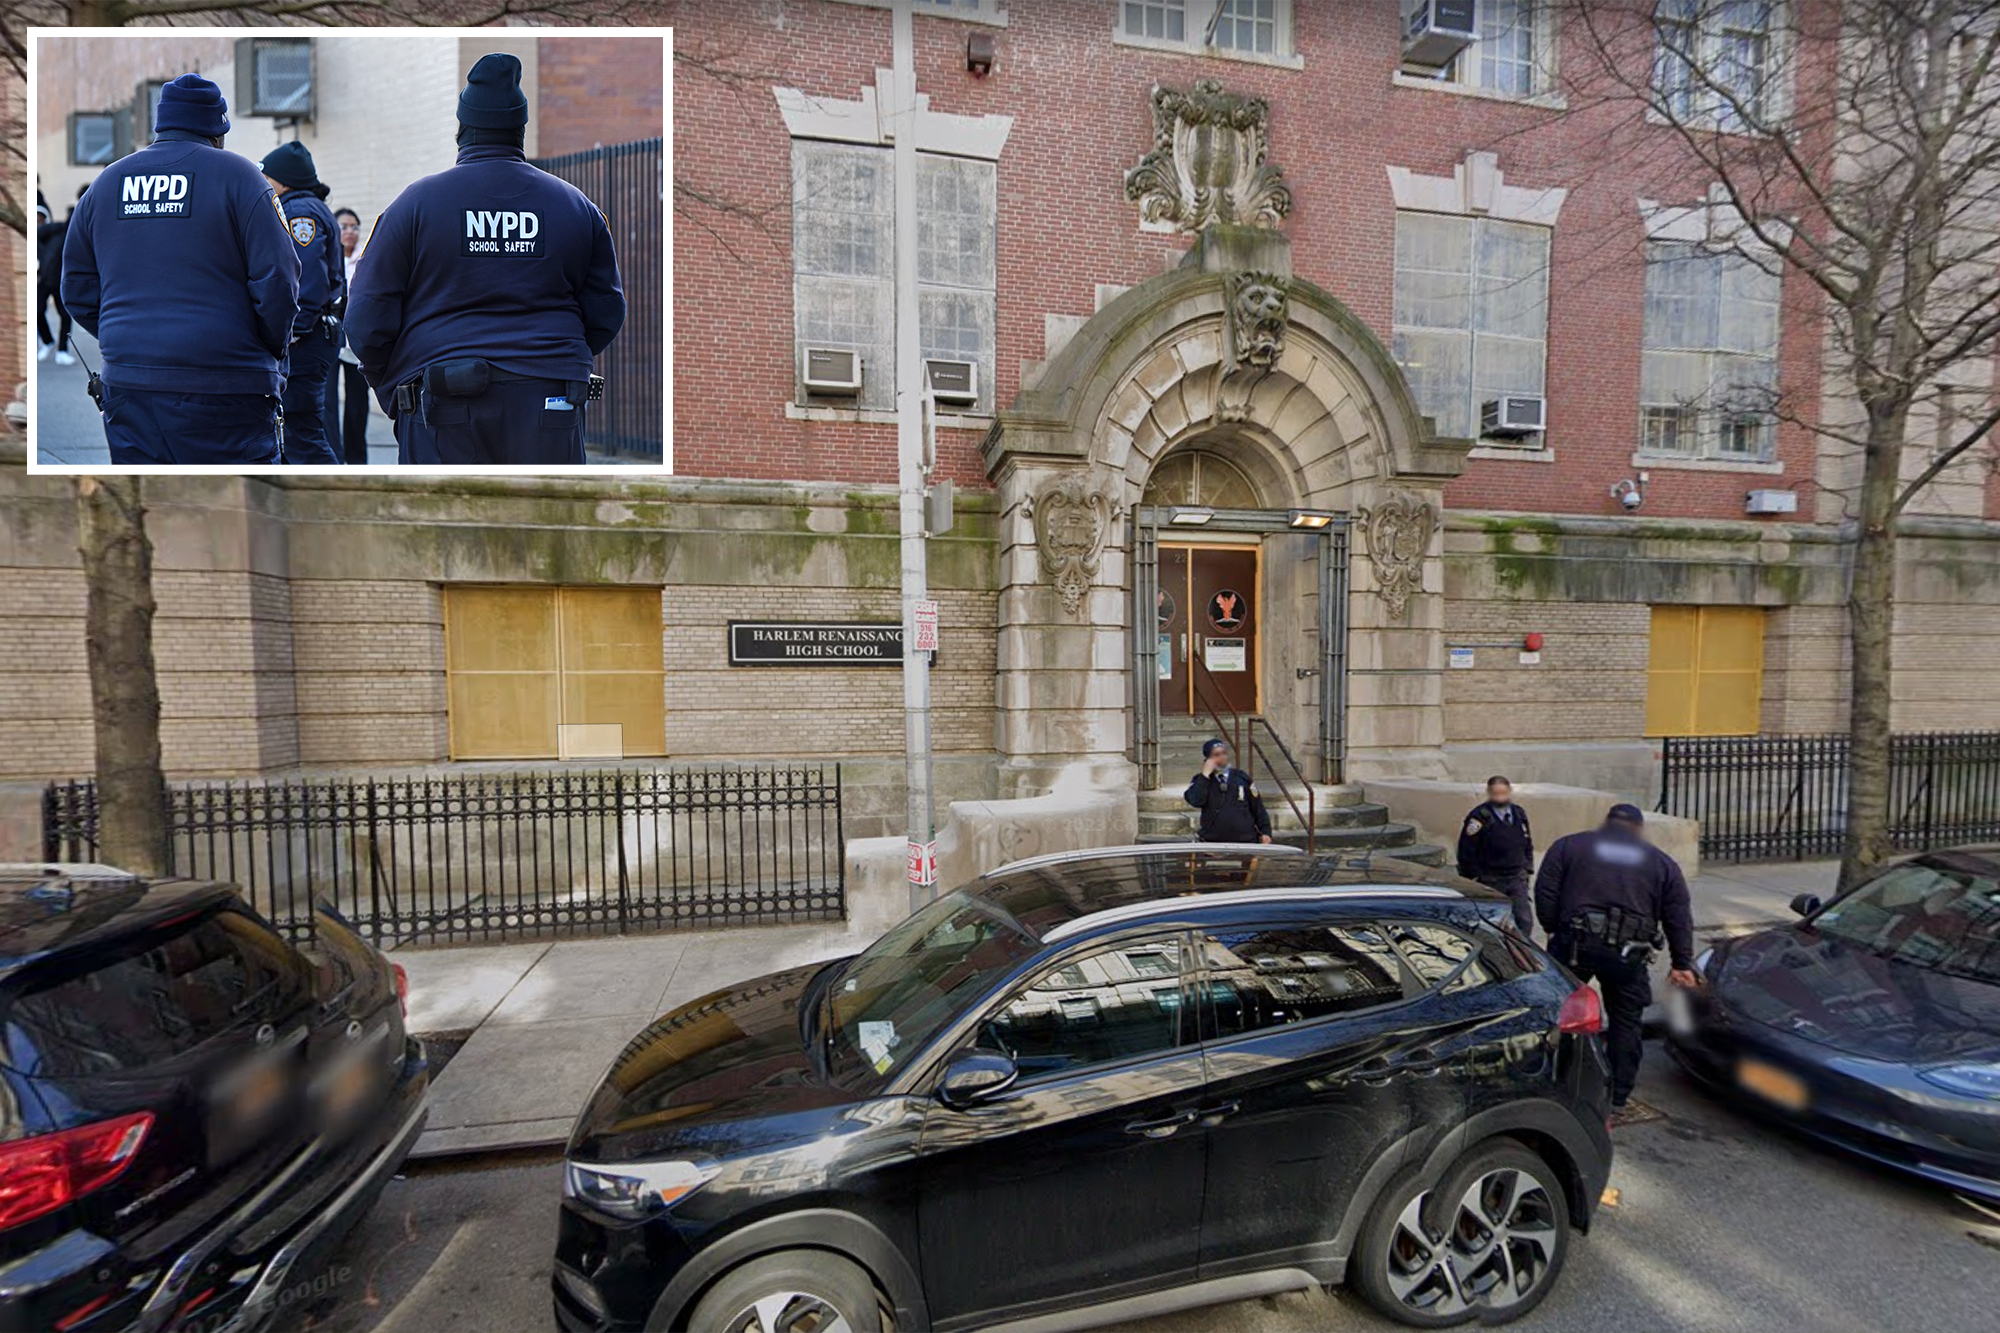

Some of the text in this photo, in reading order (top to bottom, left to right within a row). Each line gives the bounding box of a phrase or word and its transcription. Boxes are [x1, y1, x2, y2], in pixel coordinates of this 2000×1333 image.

[122, 174, 188, 202] NYPD
[124, 202, 184, 215] SCHOOL SAFETY
[466, 210, 539, 239] NYPD
[469, 241, 536, 252] SCHOOL SAFETY
[753, 630, 904, 642] HARLEM RENAISSANC
[918, 632, 935, 641] 232
[785, 645, 883, 656] HIGH SCHOOL
